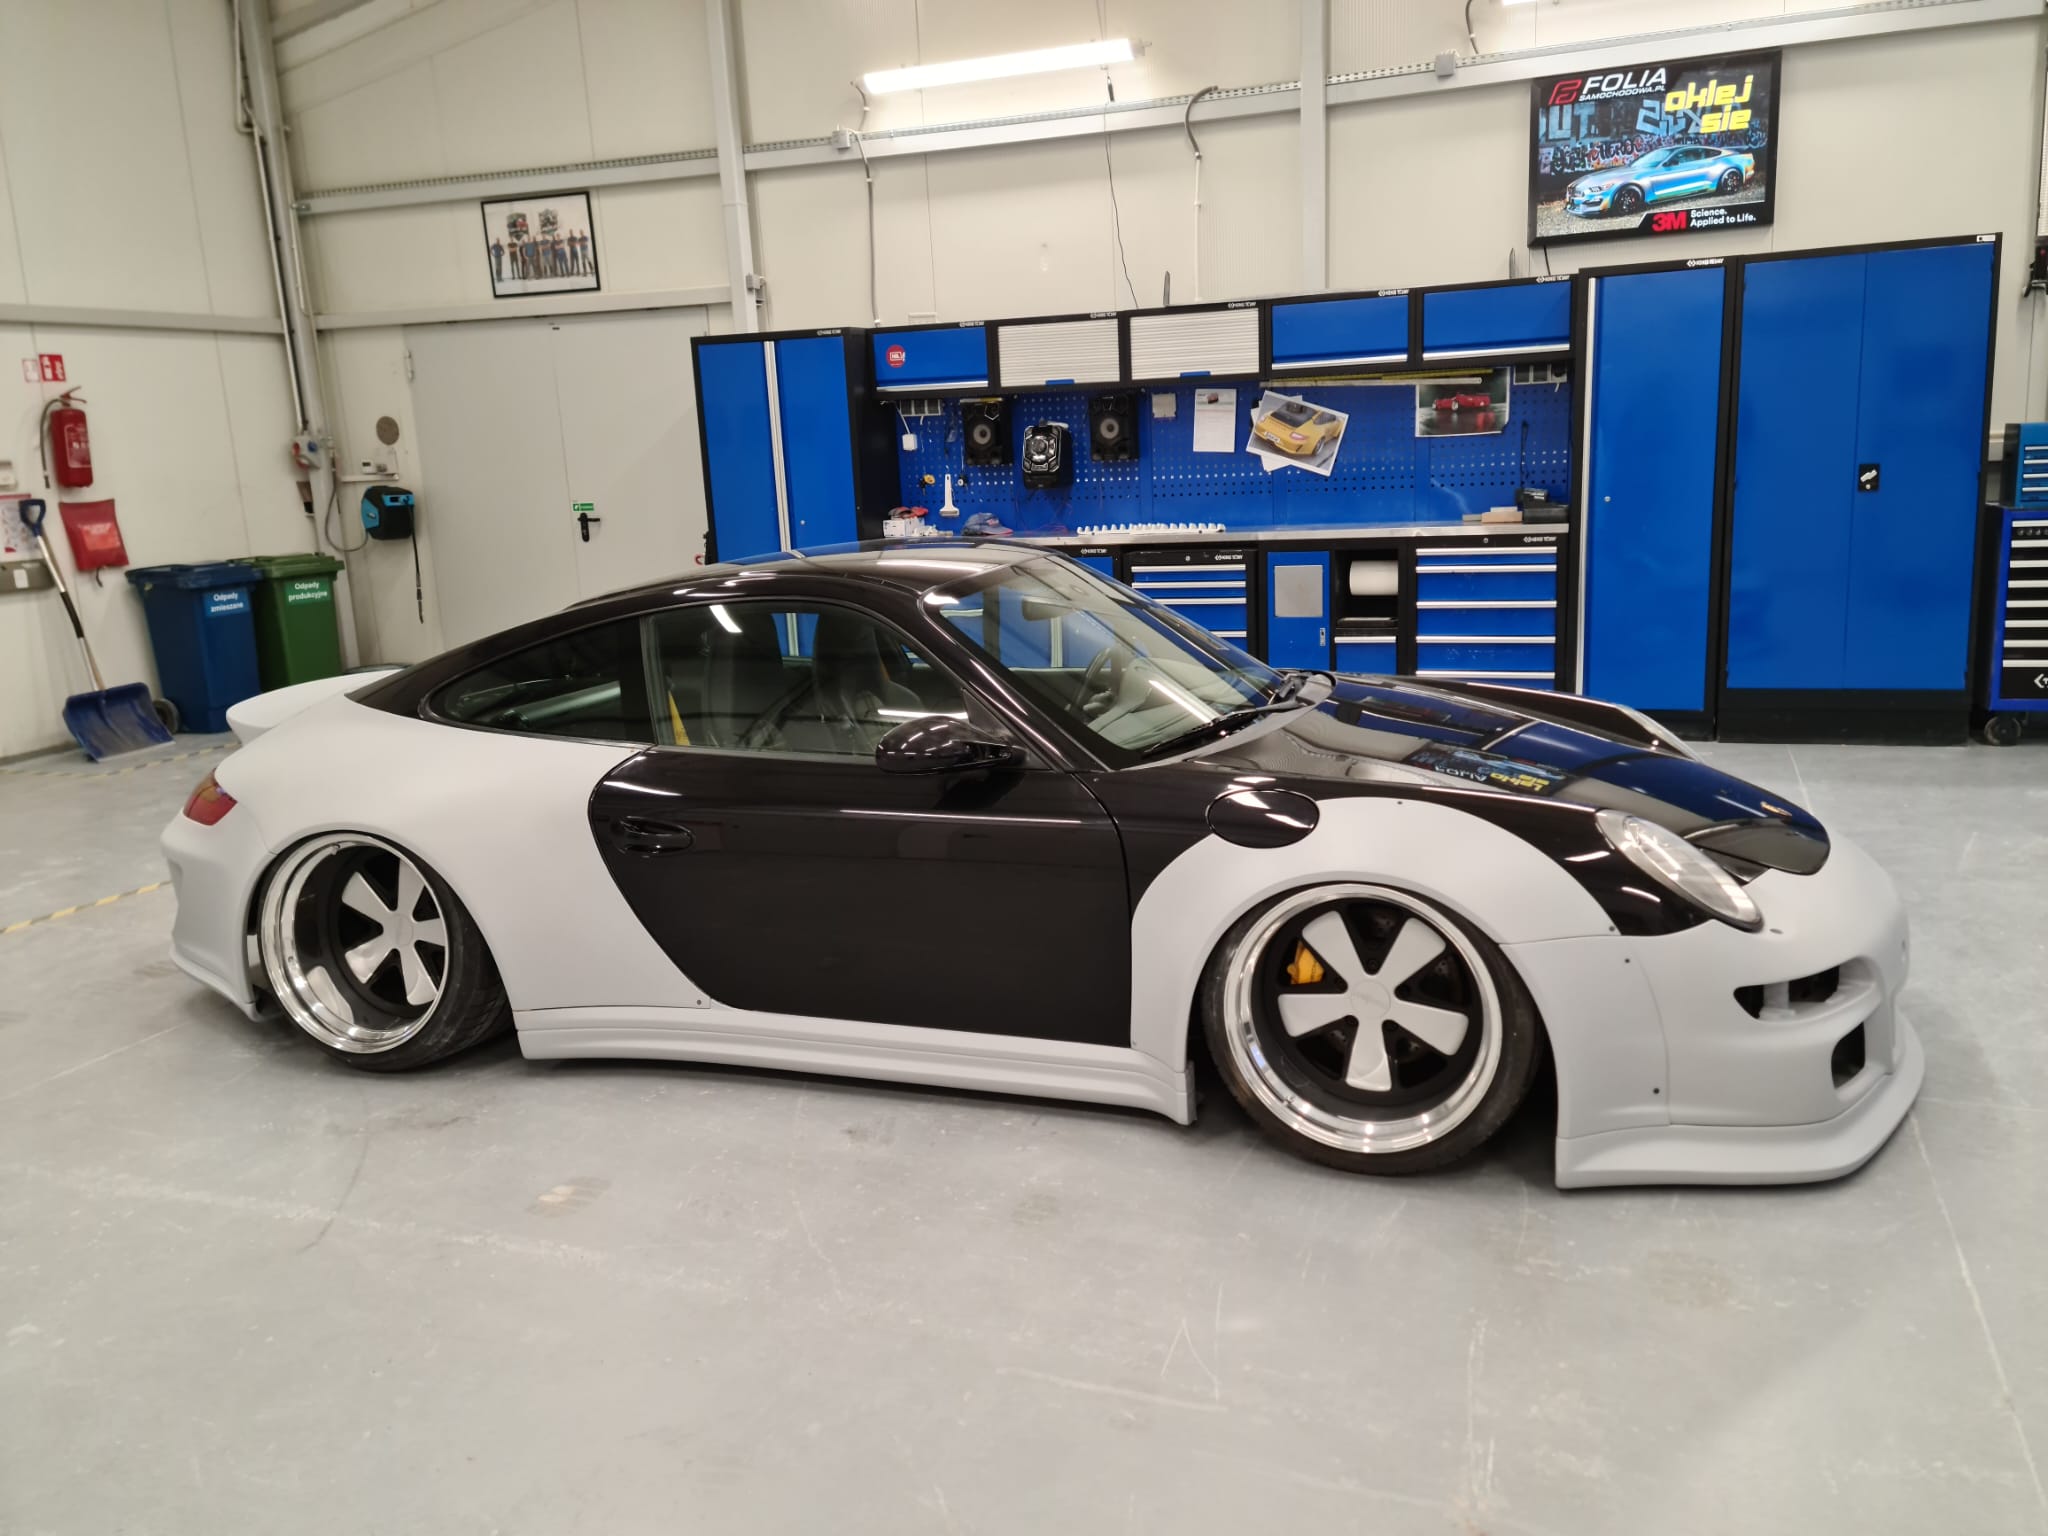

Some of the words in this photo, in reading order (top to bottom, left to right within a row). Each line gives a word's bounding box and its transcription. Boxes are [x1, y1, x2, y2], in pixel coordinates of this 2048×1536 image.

[1582, 67, 1667, 95] FOLIA
[1578, 85, 1666, 102] SAMOCHODOWA.PL
[1665, 74, 1754, 112] oklej
[1700, 104, 1752, 134] sie
[1652, 211, 1687, 232] 3M
[1690, 208, 1728, 218] Science.
[1690, 215, 1725, 228] Applied
[1726, 215, 1735, 223] to
[1737, 212, 1757, 223] Life.
[294, 581, 320, 590] Odpady
